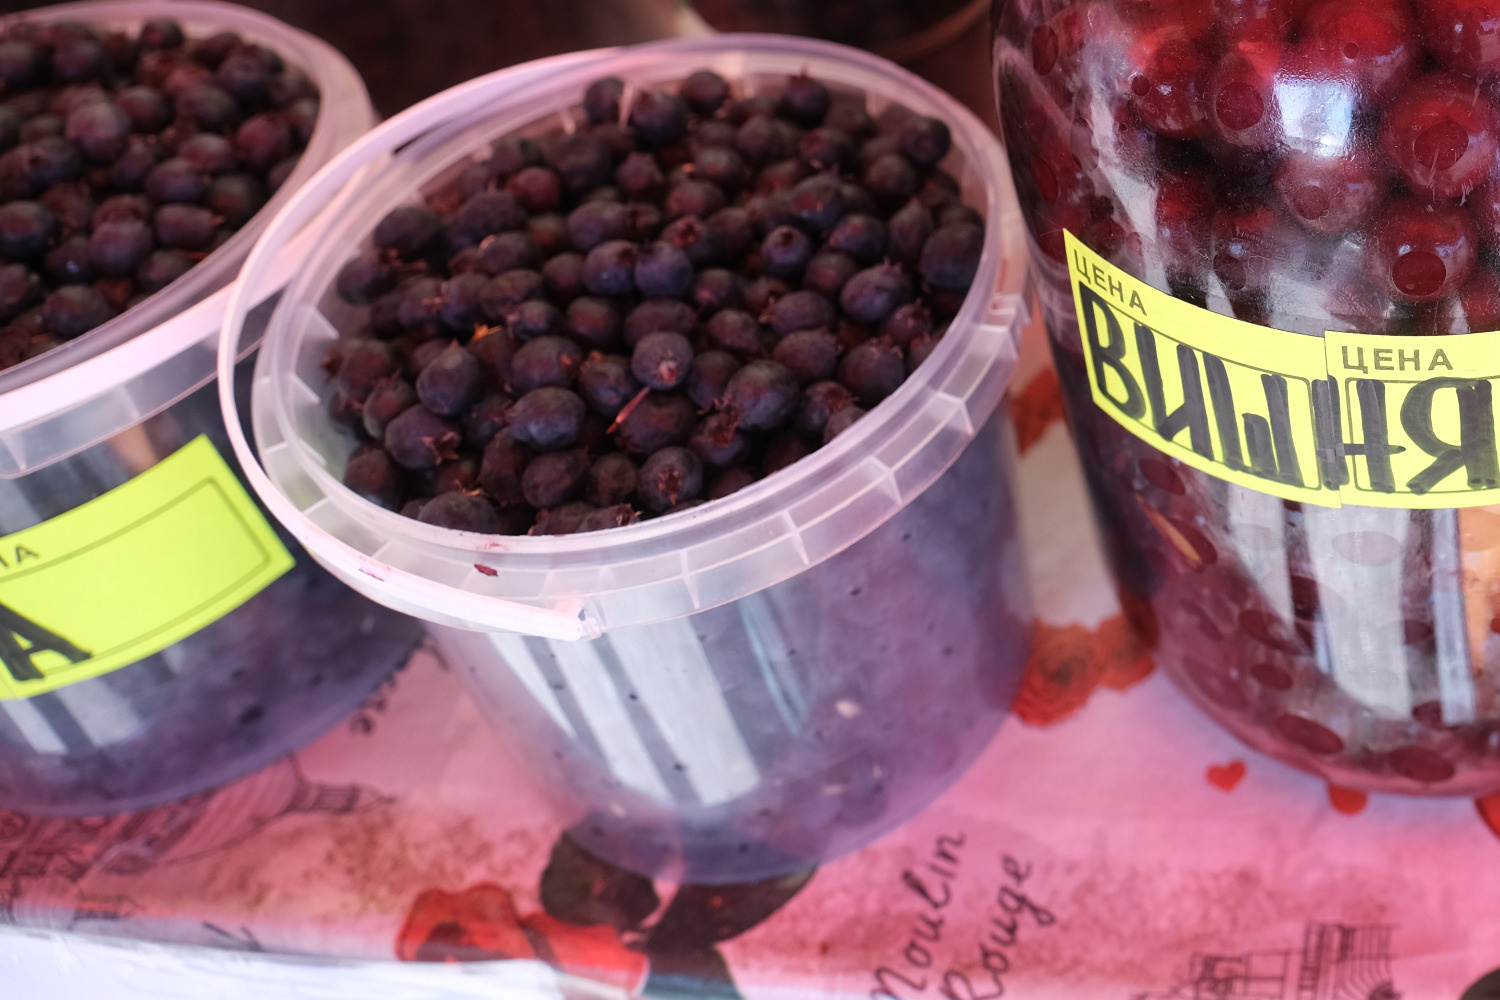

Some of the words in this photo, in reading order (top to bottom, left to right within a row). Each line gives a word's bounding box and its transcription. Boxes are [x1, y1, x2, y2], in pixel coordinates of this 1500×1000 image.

[1073, 248, 1148, 317] ЦЕНА
[1078, 280, 1500, 496] ВИШНЯ
[1341, 345, 1454, 374] ЦЕНА
